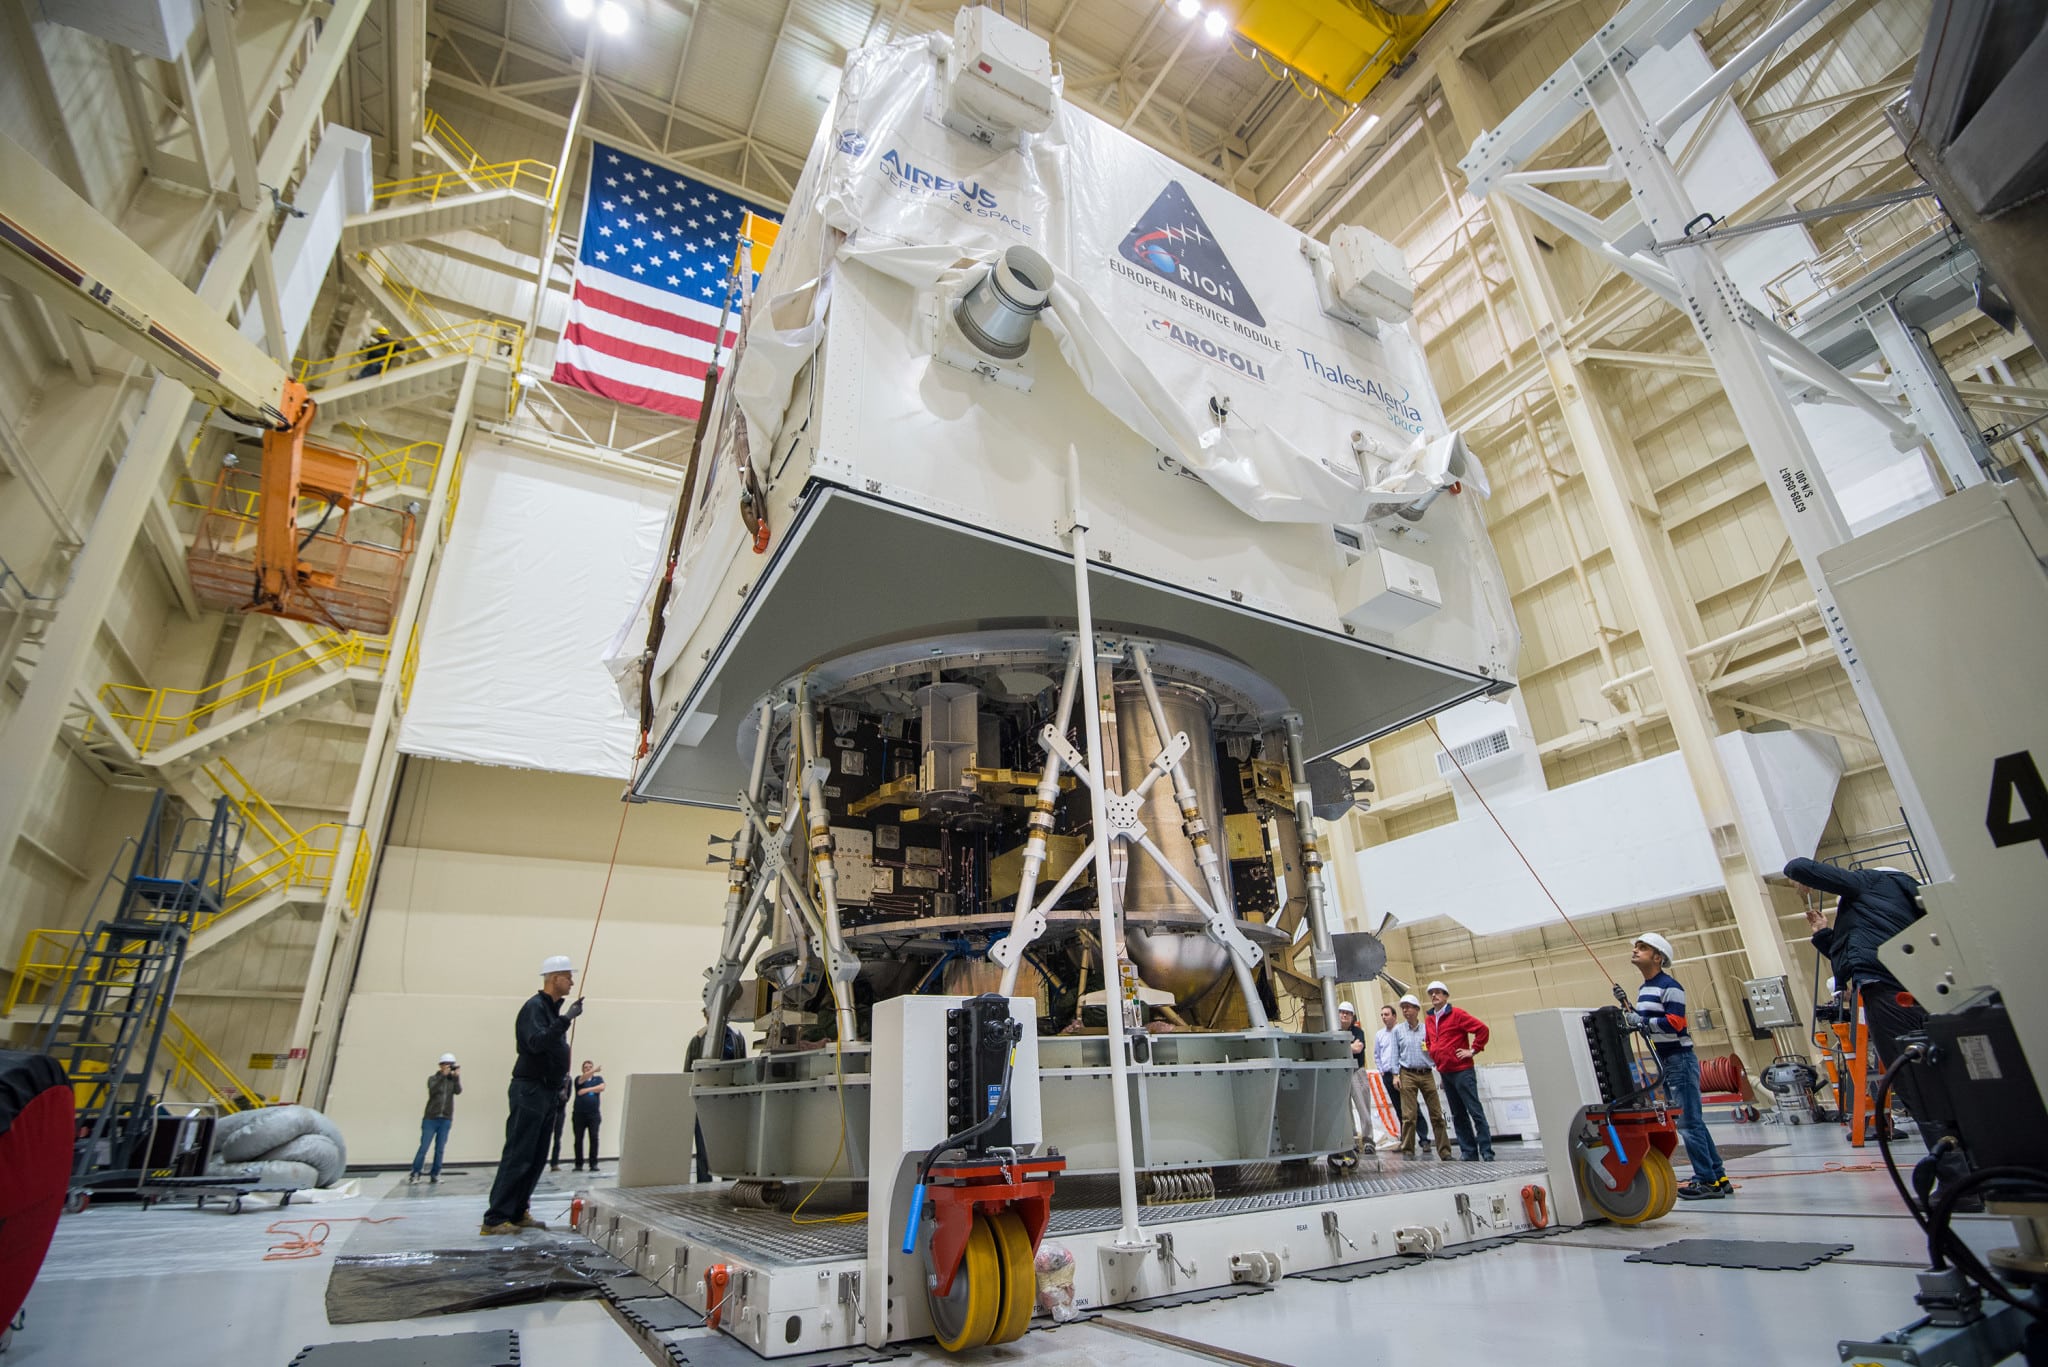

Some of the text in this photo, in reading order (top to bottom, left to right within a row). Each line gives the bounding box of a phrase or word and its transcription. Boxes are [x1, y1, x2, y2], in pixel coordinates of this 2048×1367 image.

[882, 149, 998, 209] AIRBUS
[963, 201, 973, 213] &
[977, 208, 1033, 236] SPACE
[1109, 258, 1283, 352] EUROPEAN SERVICE MODULE
[1385, 406, 1425, 436] Space
[1985, 749, 2048, 862] 4
